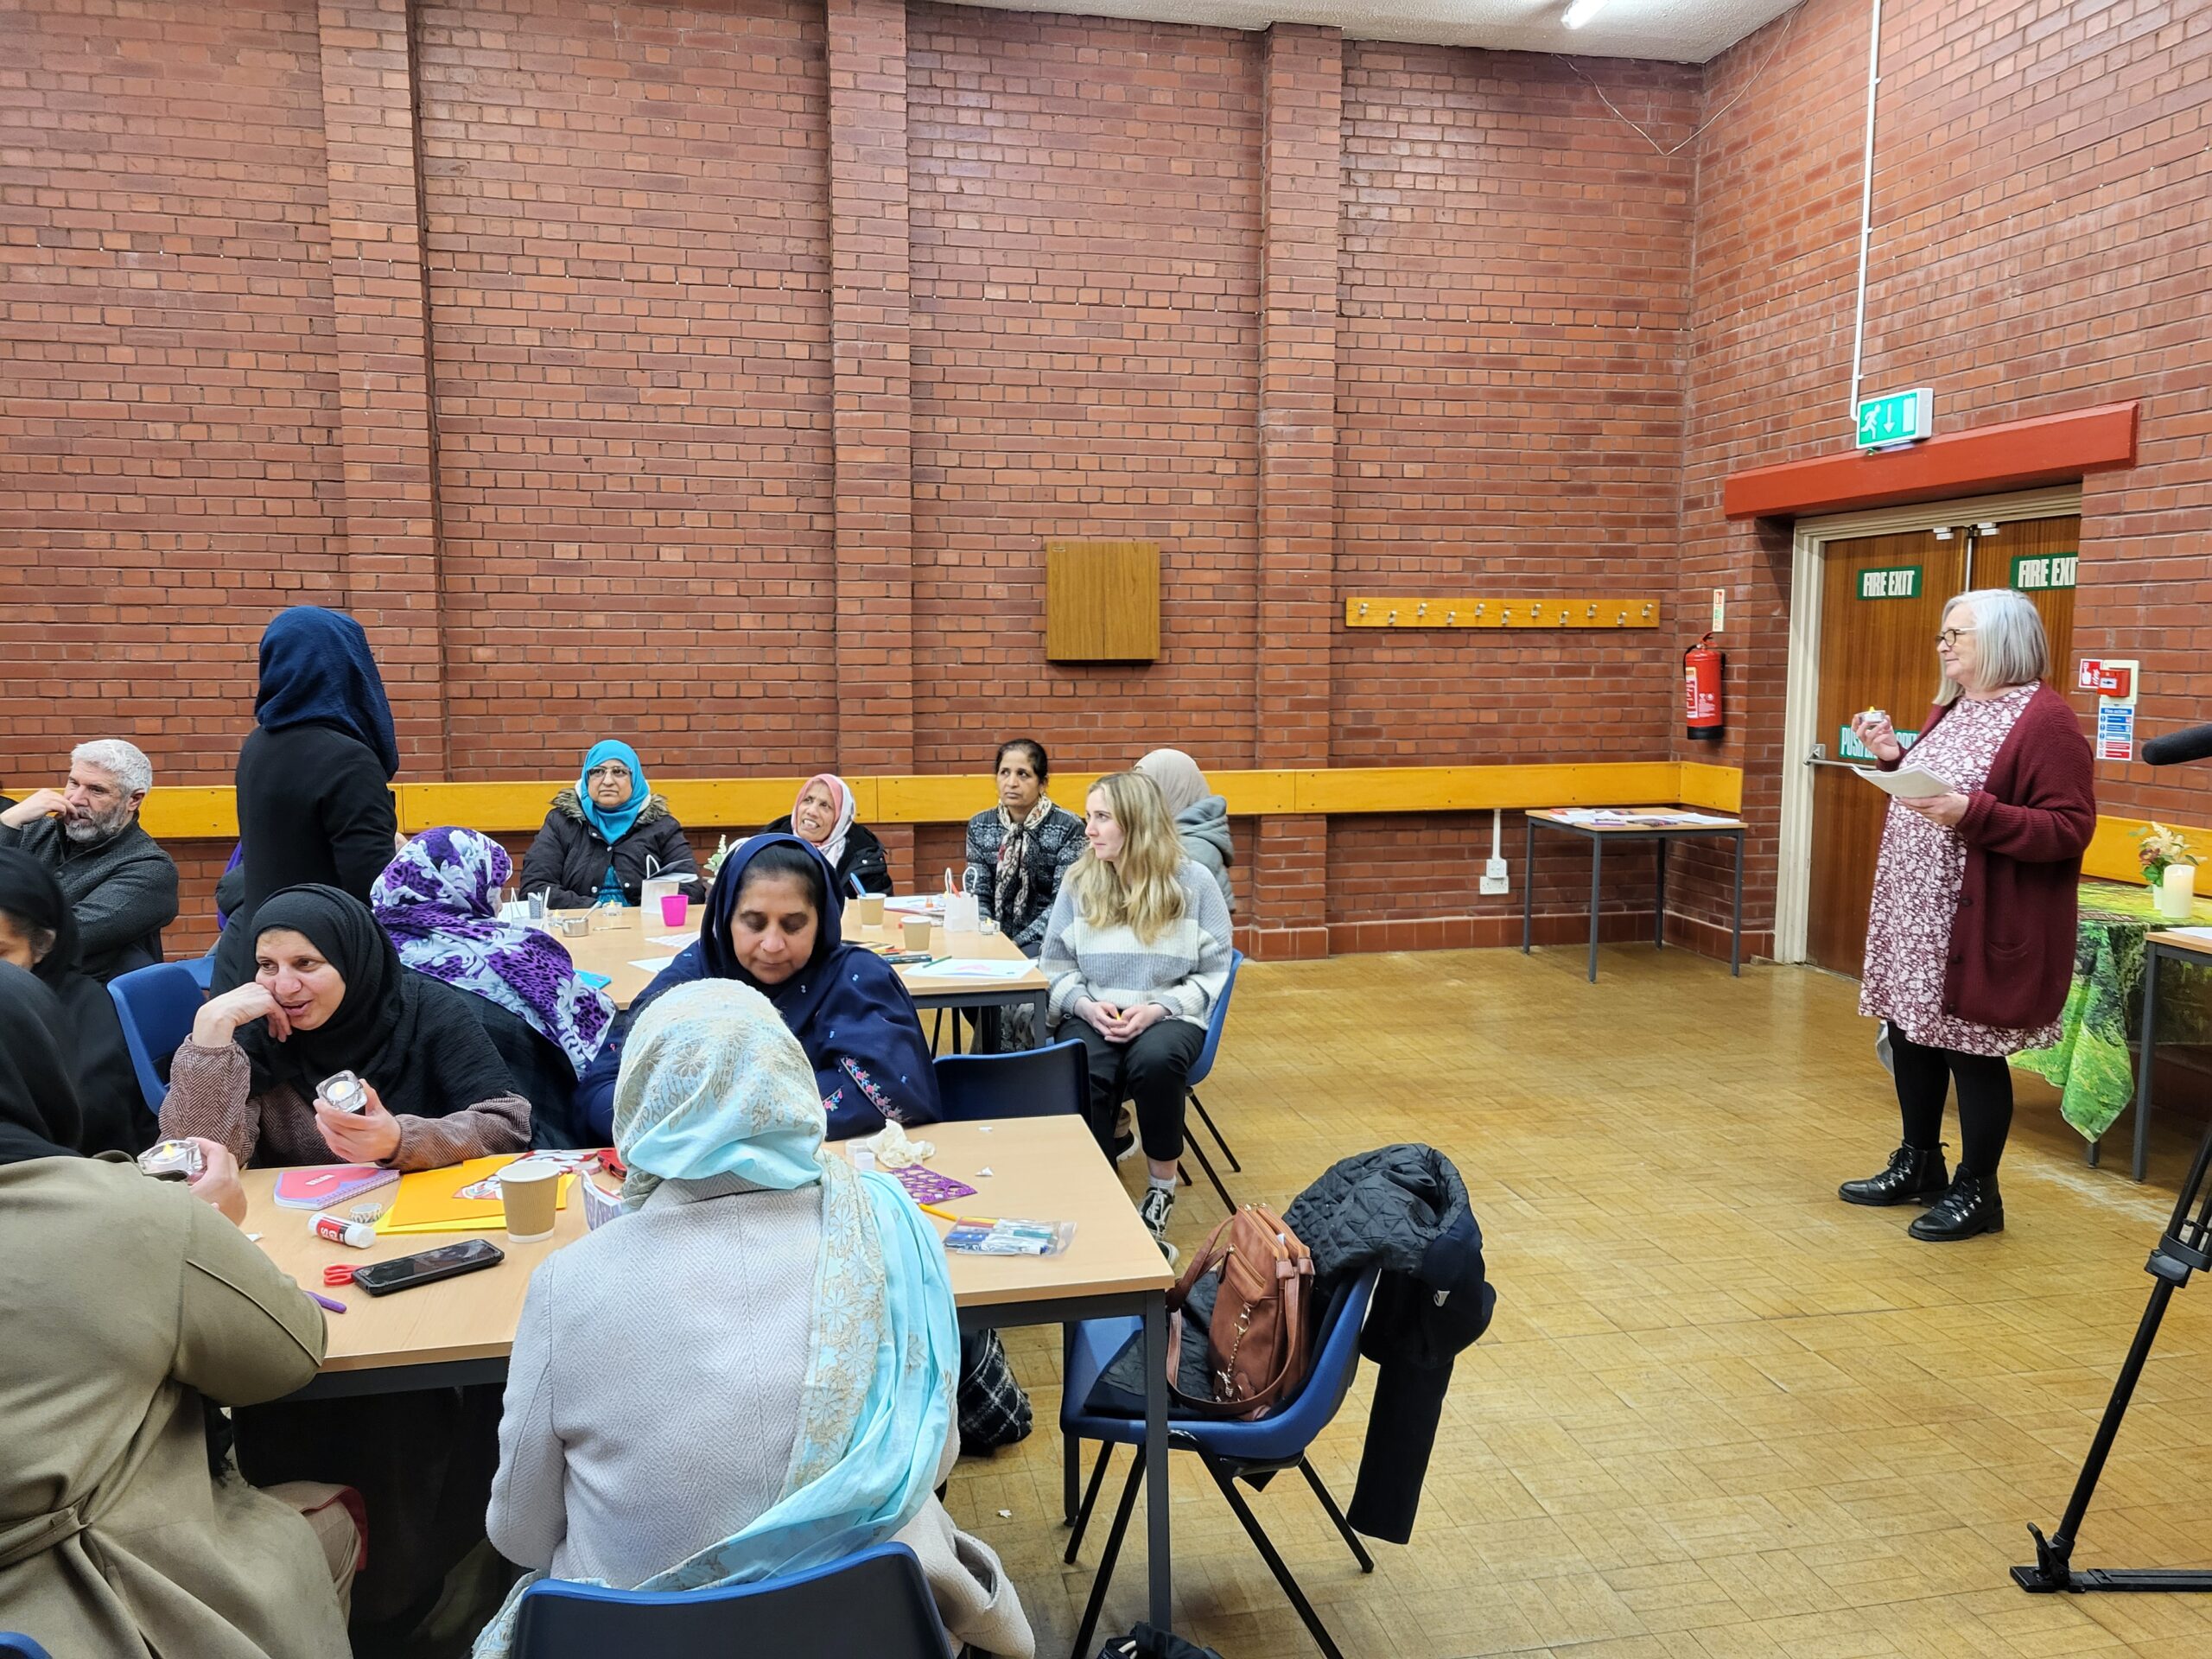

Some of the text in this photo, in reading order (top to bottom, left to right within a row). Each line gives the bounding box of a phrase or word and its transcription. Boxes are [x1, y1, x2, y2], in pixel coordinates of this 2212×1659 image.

[1863, 570, 1915, 597] FIRE EXIT
[2018, 556, 2078, 588] FIRE EXI
